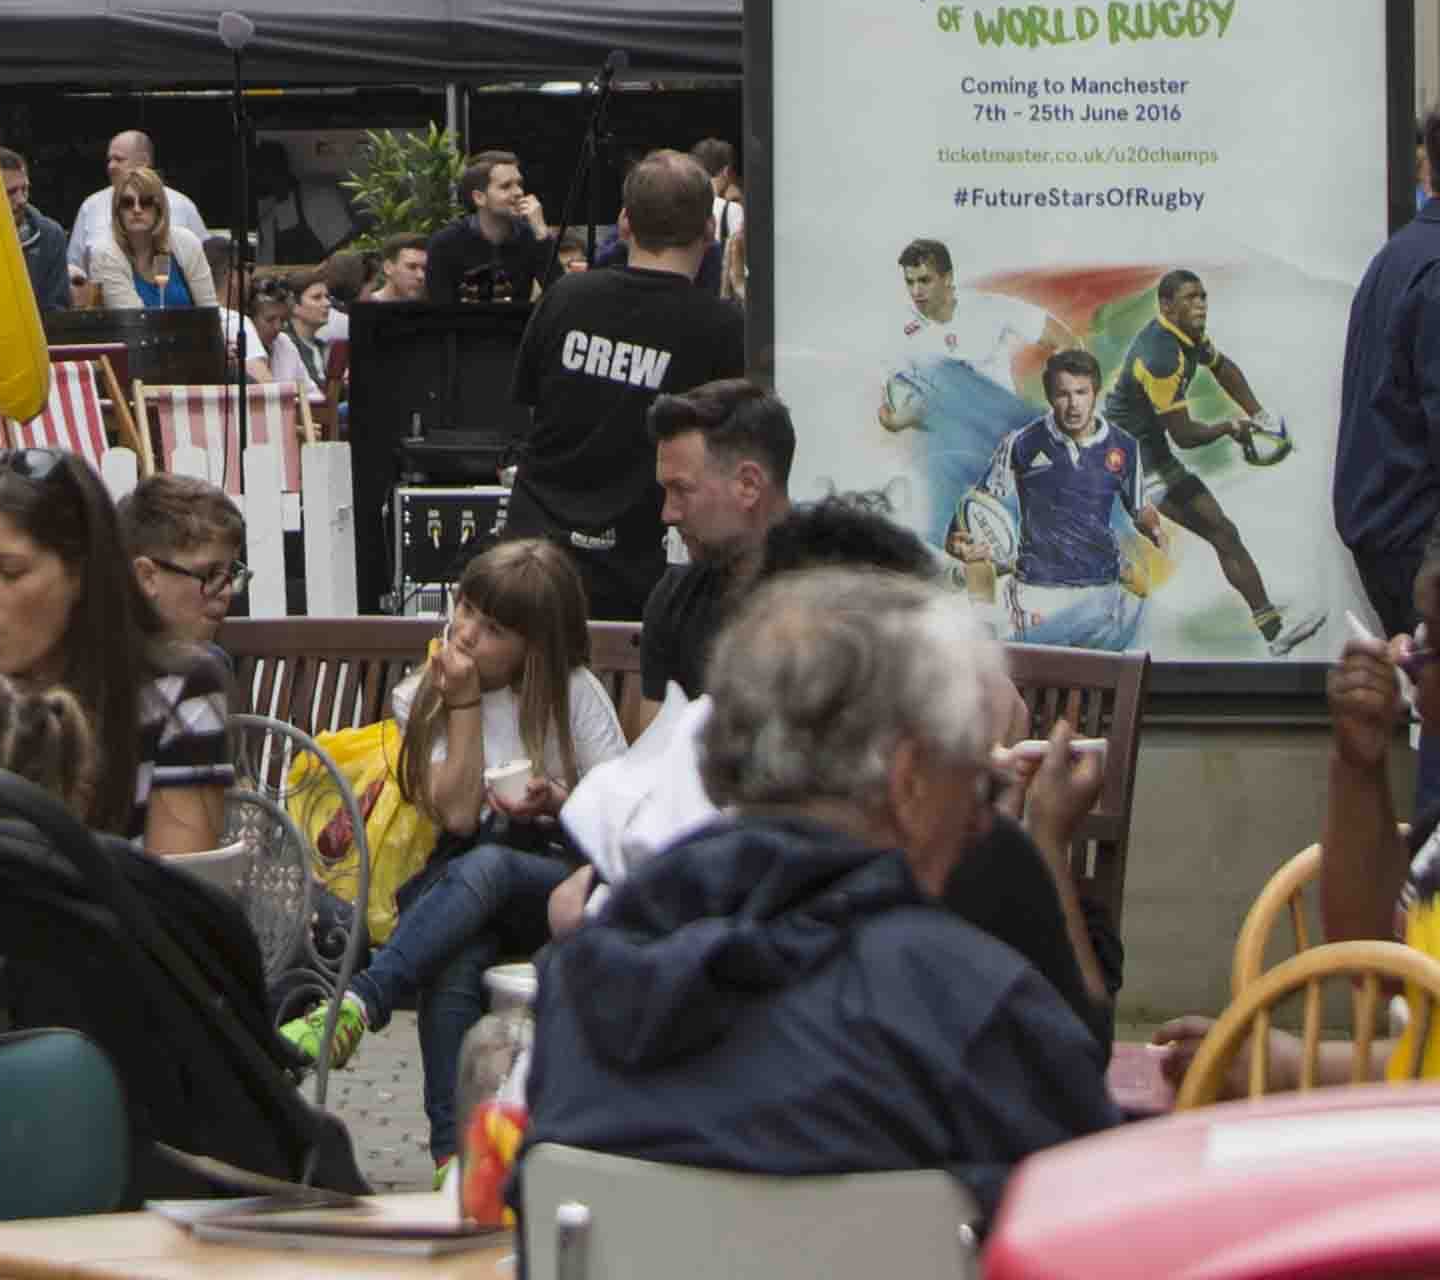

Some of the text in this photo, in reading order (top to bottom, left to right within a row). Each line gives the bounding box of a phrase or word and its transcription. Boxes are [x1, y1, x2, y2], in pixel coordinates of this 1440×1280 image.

[937, 5, 964, 32] OF
[974, 5, 1099, 48] WORLD
[960, 76, 1189, 98] Coming to Manchester
[974, 103, 1006, 121] 7th
[1029, 103, 1074, 121] 25th
[1079, 103, 1129, 121] June
[1135, 103, 1182, 121] 2016
[937, 146, 1219, 167] ticketmaster.co.uk/u20champs
[954, 187, 1205, 211] #FutureStarsOfRugby
[562, 329, 672, 390] CREW
